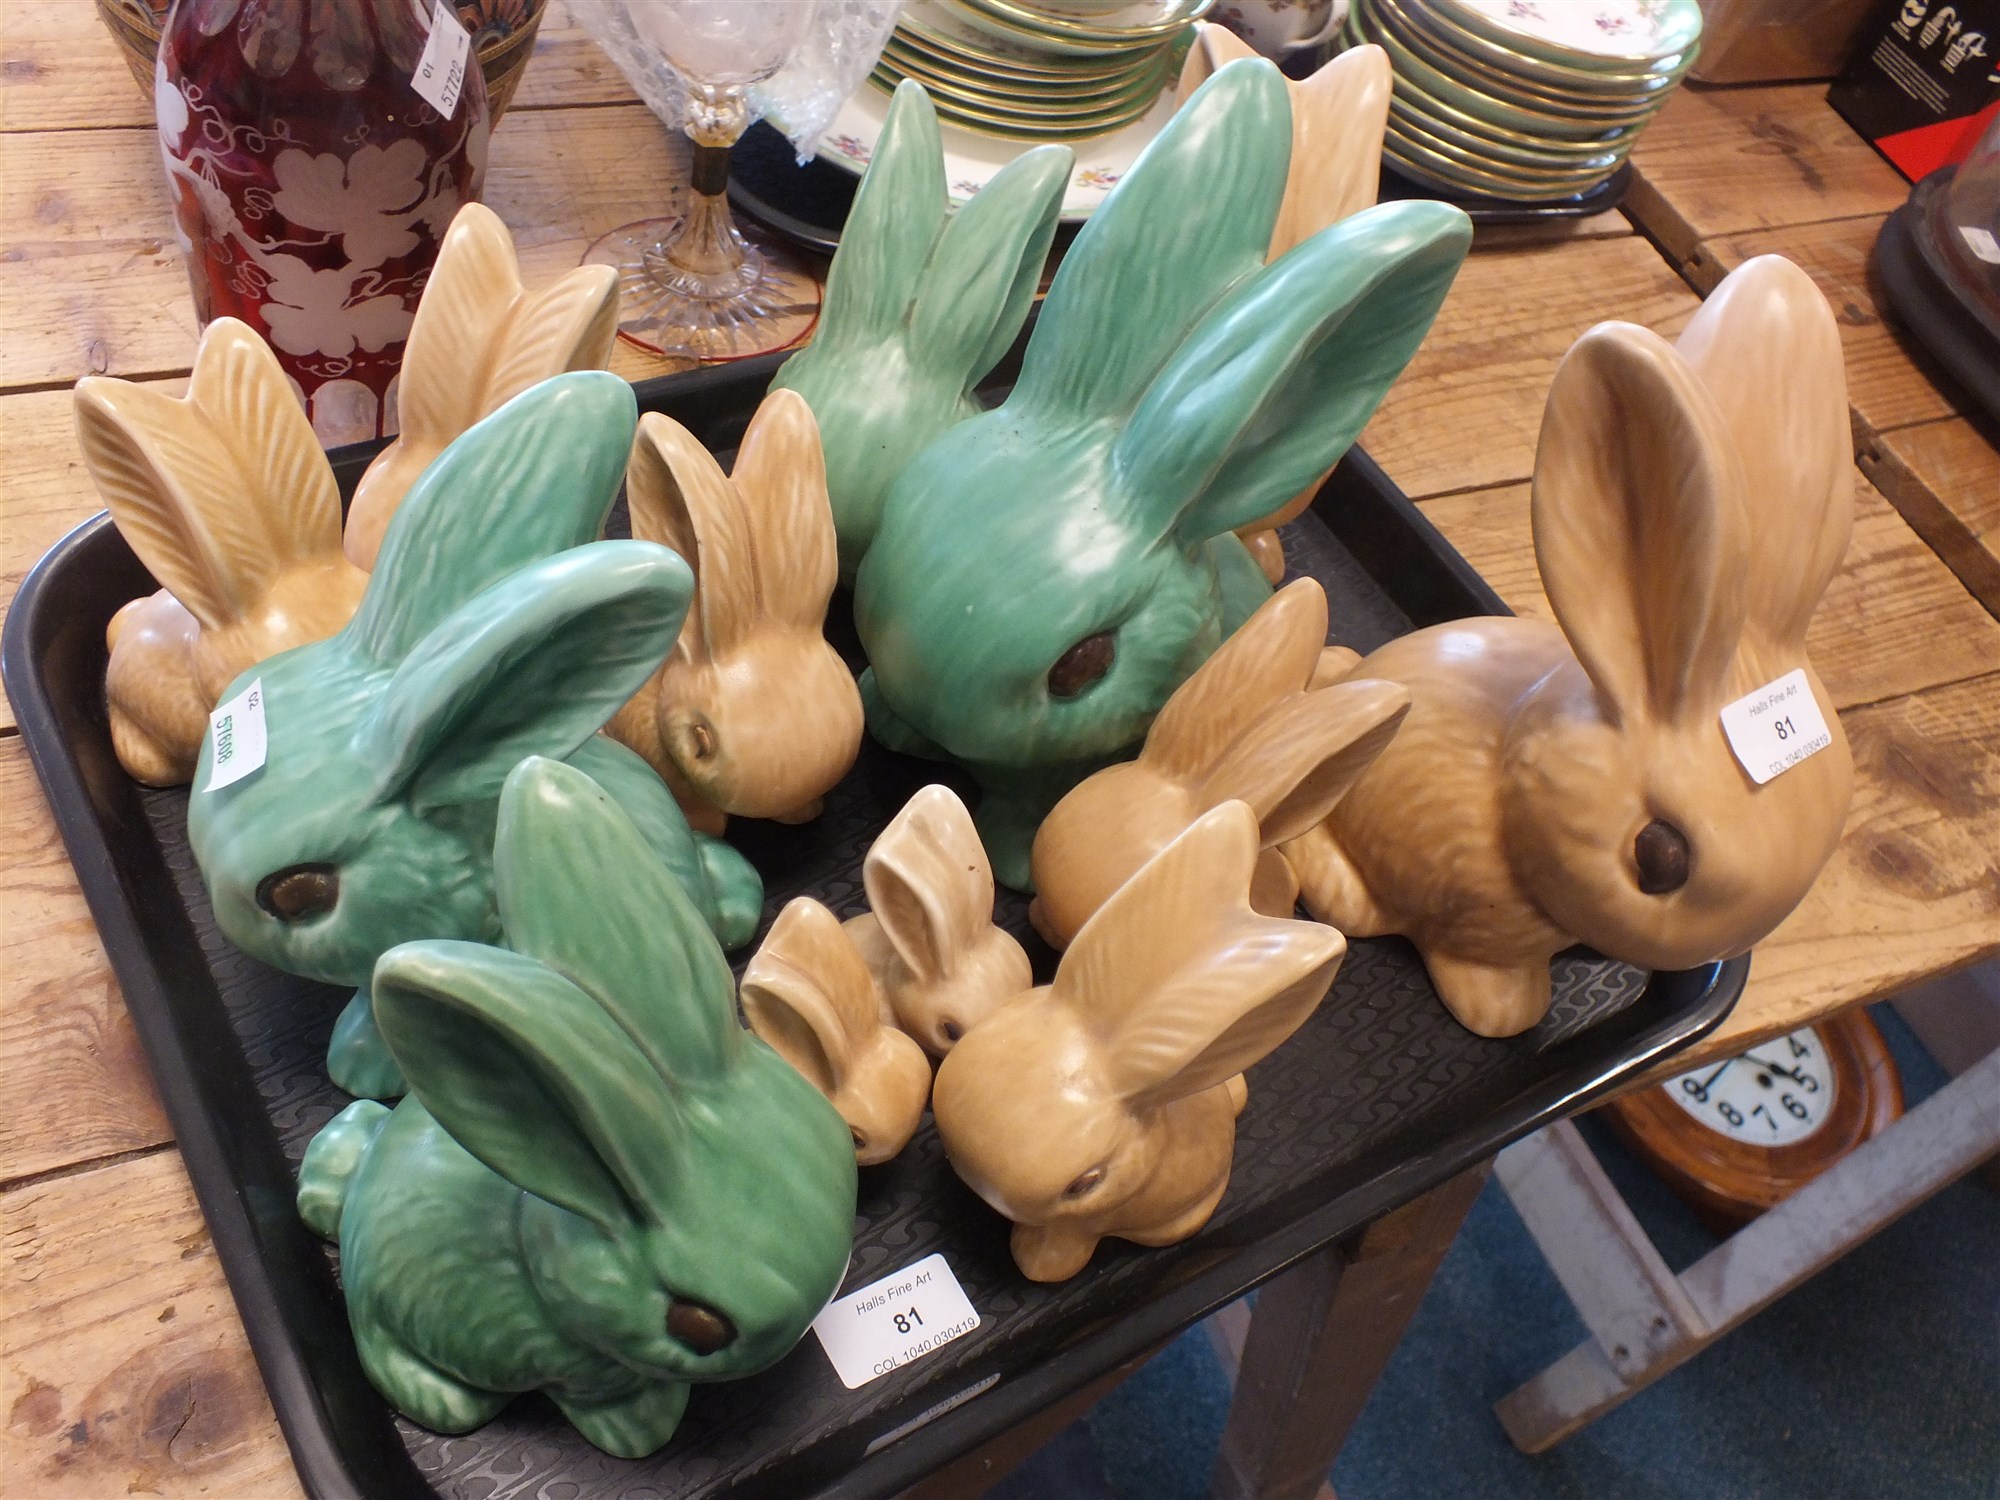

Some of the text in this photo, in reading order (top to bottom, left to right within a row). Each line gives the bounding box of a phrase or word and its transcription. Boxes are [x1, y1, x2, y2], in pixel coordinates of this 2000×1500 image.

[248, 691, 259, 711] 02
[1749, 684, 1798, 717] Halls Fine Art
[216, 714, 232, 764] 57608
[1774, 715, 1796, 740] 81
[1769, 733, 1829, 775] COL 1040 030419
[1786, 1035, 1811, 1058] 4
[1791, 1066, 1819, 1093] 5
[1718, 1102, 1744, 1126] 8
[1752, 1104, 1778, 1130] 7
[1781, 1093, 1808, 1119] 6
[856, 1271, 932, 1316] Halls Fine Art
[893, 1306, 924, 1334] 81
[873, 1317, 976, 1375] COL 1040 030419
